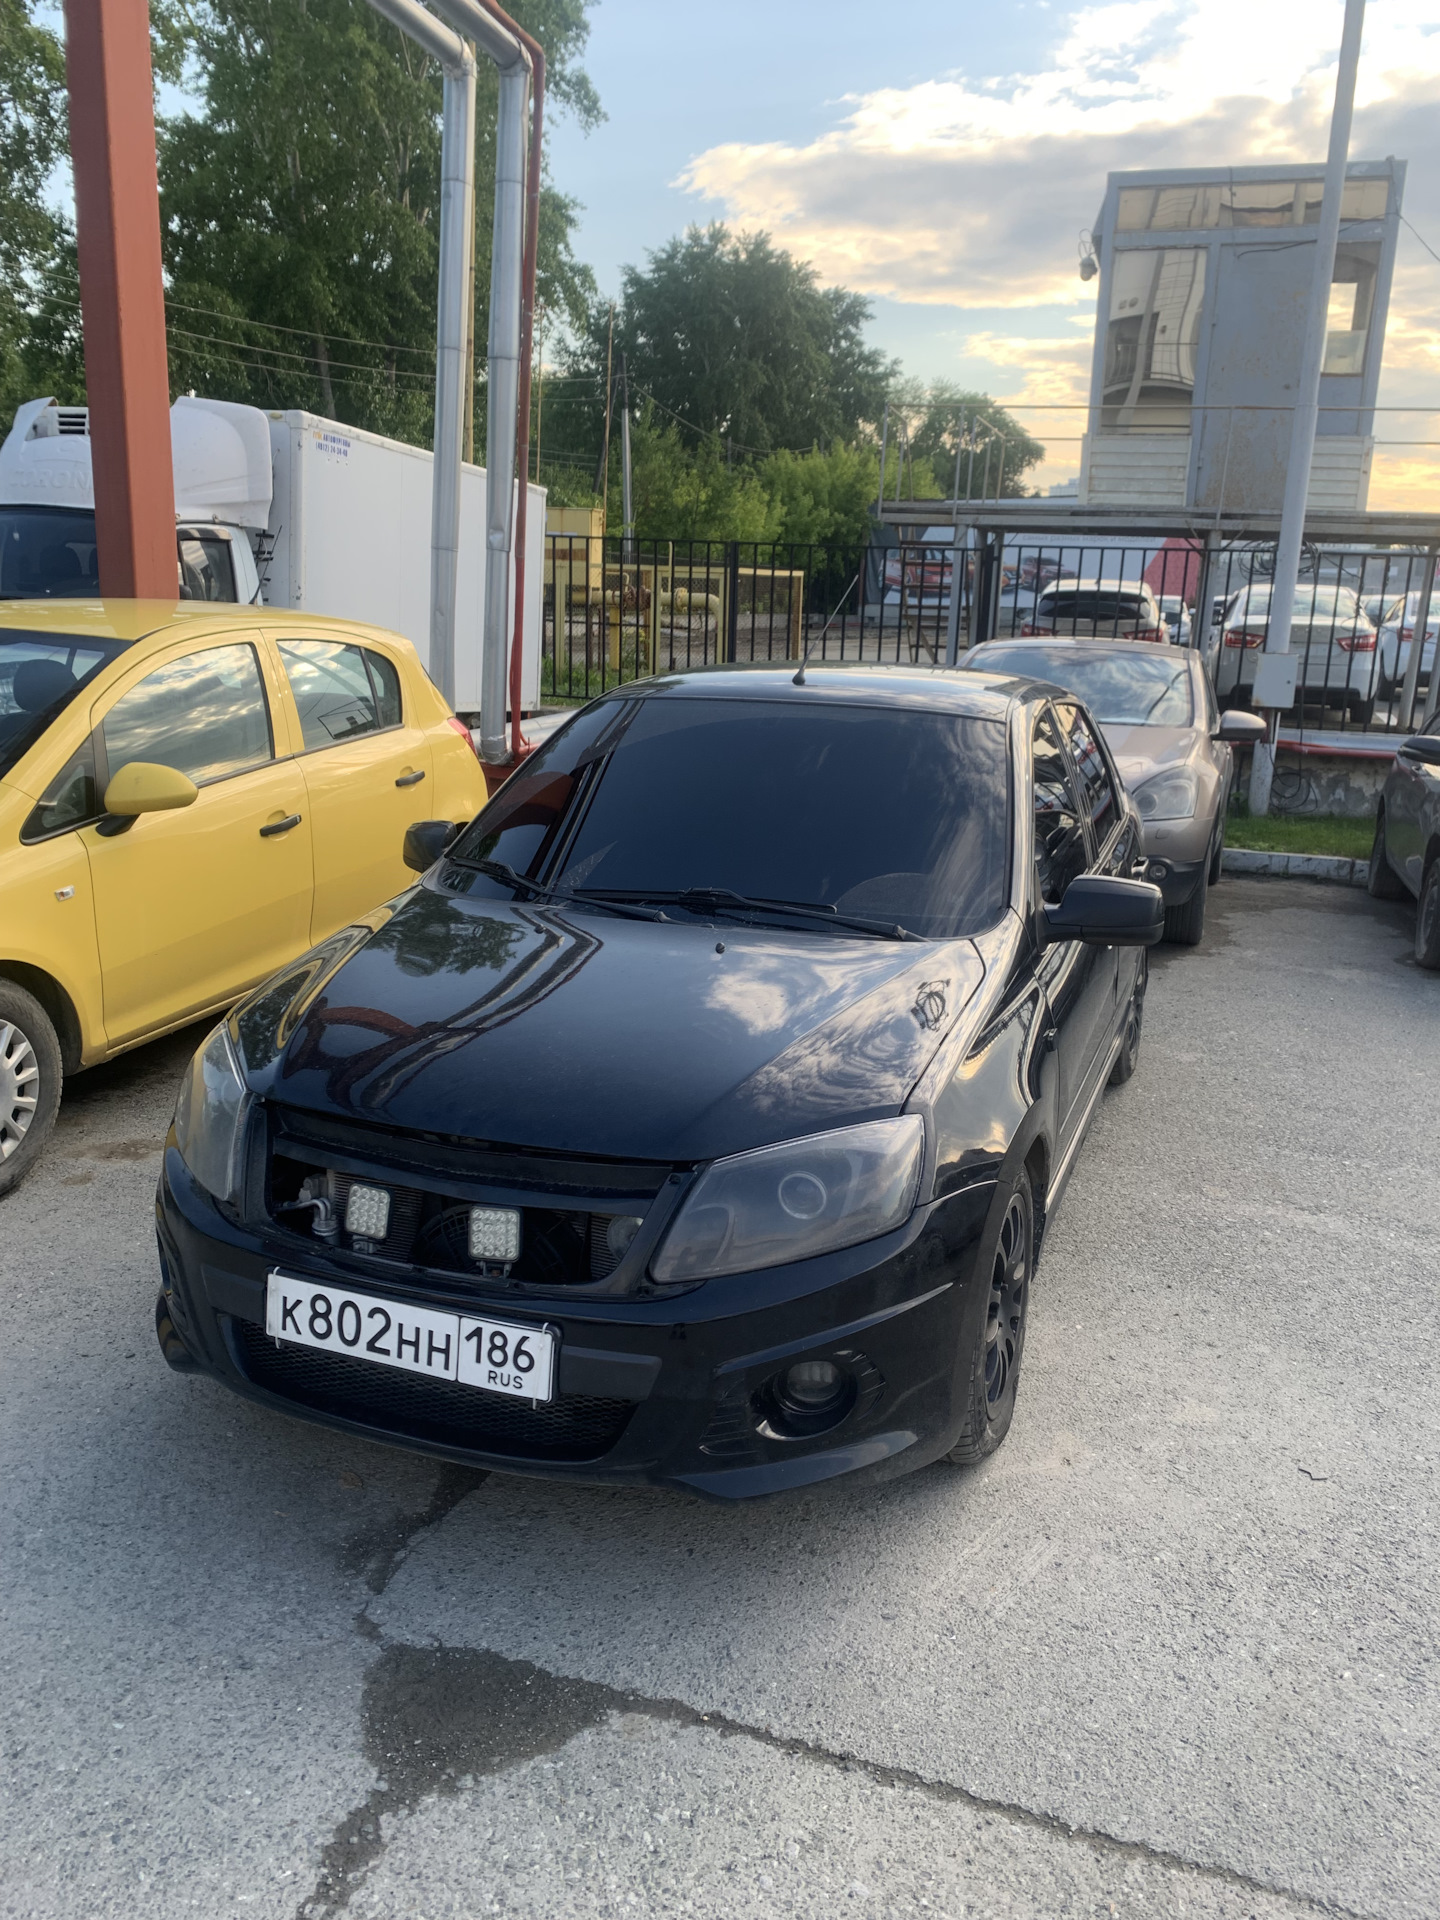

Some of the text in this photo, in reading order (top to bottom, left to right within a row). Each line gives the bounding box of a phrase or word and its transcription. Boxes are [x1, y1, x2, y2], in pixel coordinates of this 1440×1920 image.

[281, 1293, 535, 1373] К802НН 186
[487, 1370, 523, 1389] RUS
